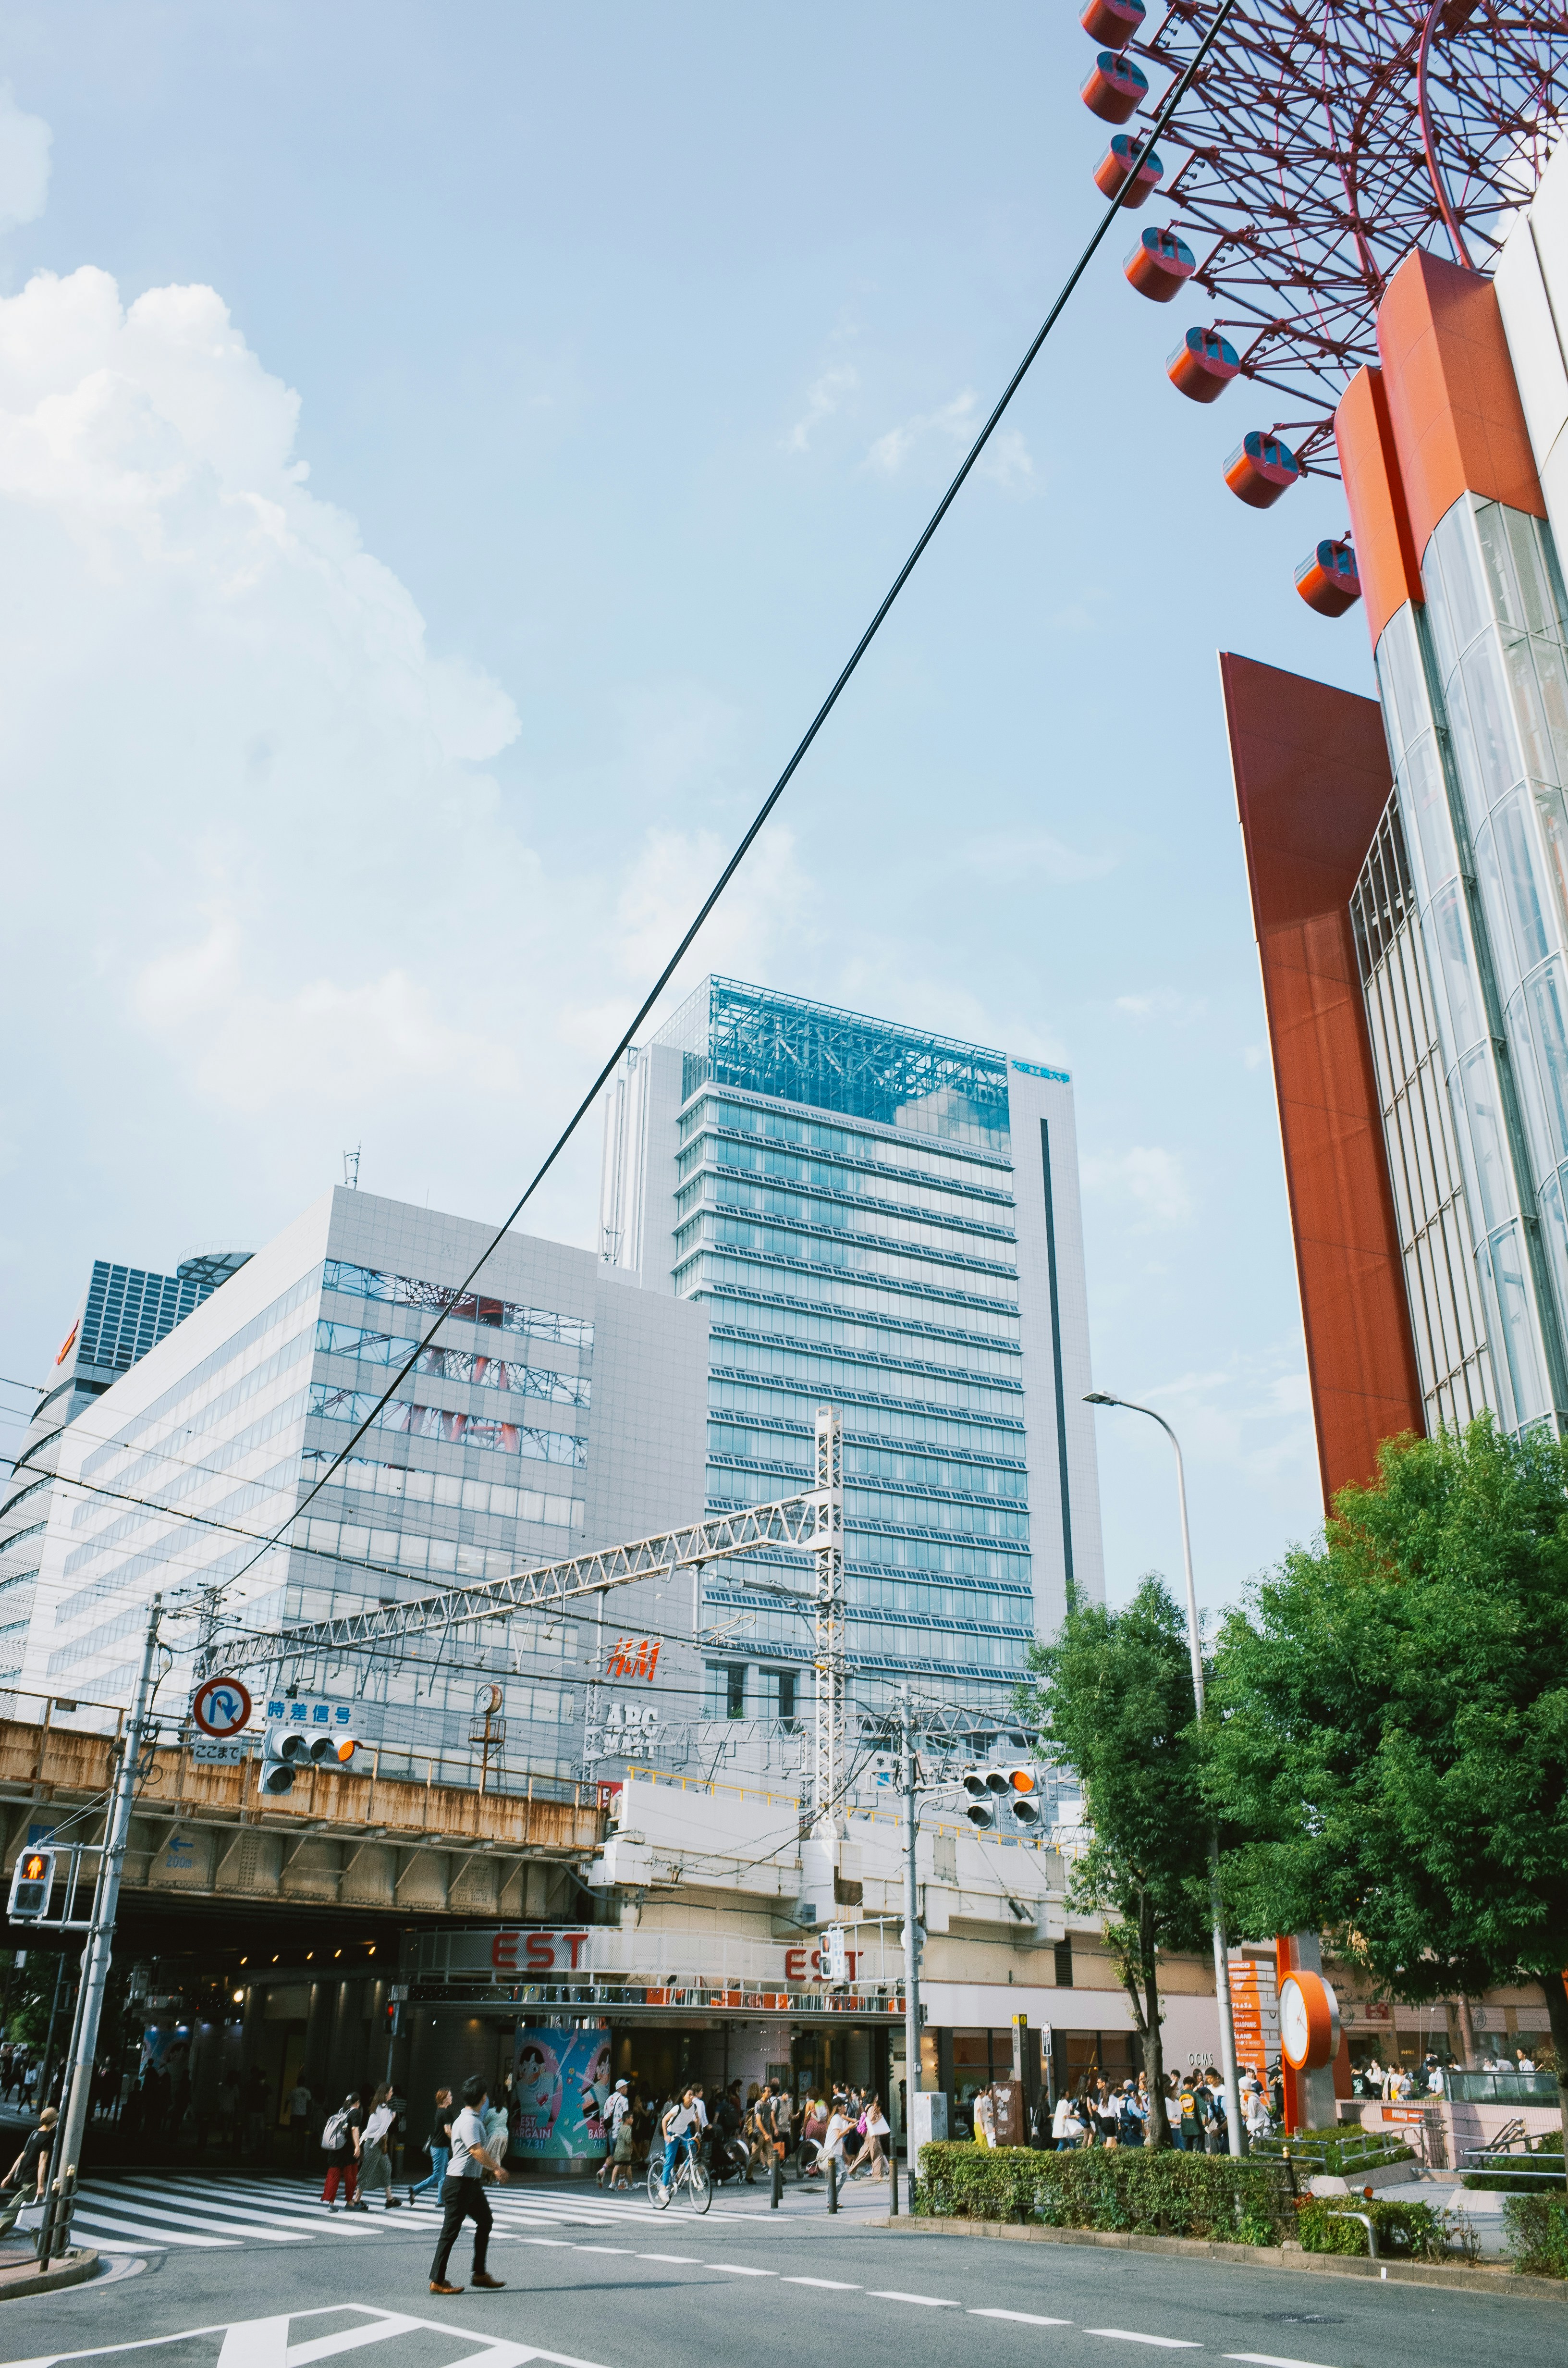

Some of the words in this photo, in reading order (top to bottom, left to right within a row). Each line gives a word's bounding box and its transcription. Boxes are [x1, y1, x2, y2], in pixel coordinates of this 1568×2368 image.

[606, 1637, 660, 1682] H&M
[268, 1701, 351, 1724] 時差信号
[606, 1702, 658, 1737] ABC
[196, 1745, 239, 1759] ここまで
[166, 1855, 192, 1868] 200m
[492, 1933, 588, 1968] EST
[520, 2116, 537, 2126] EST
